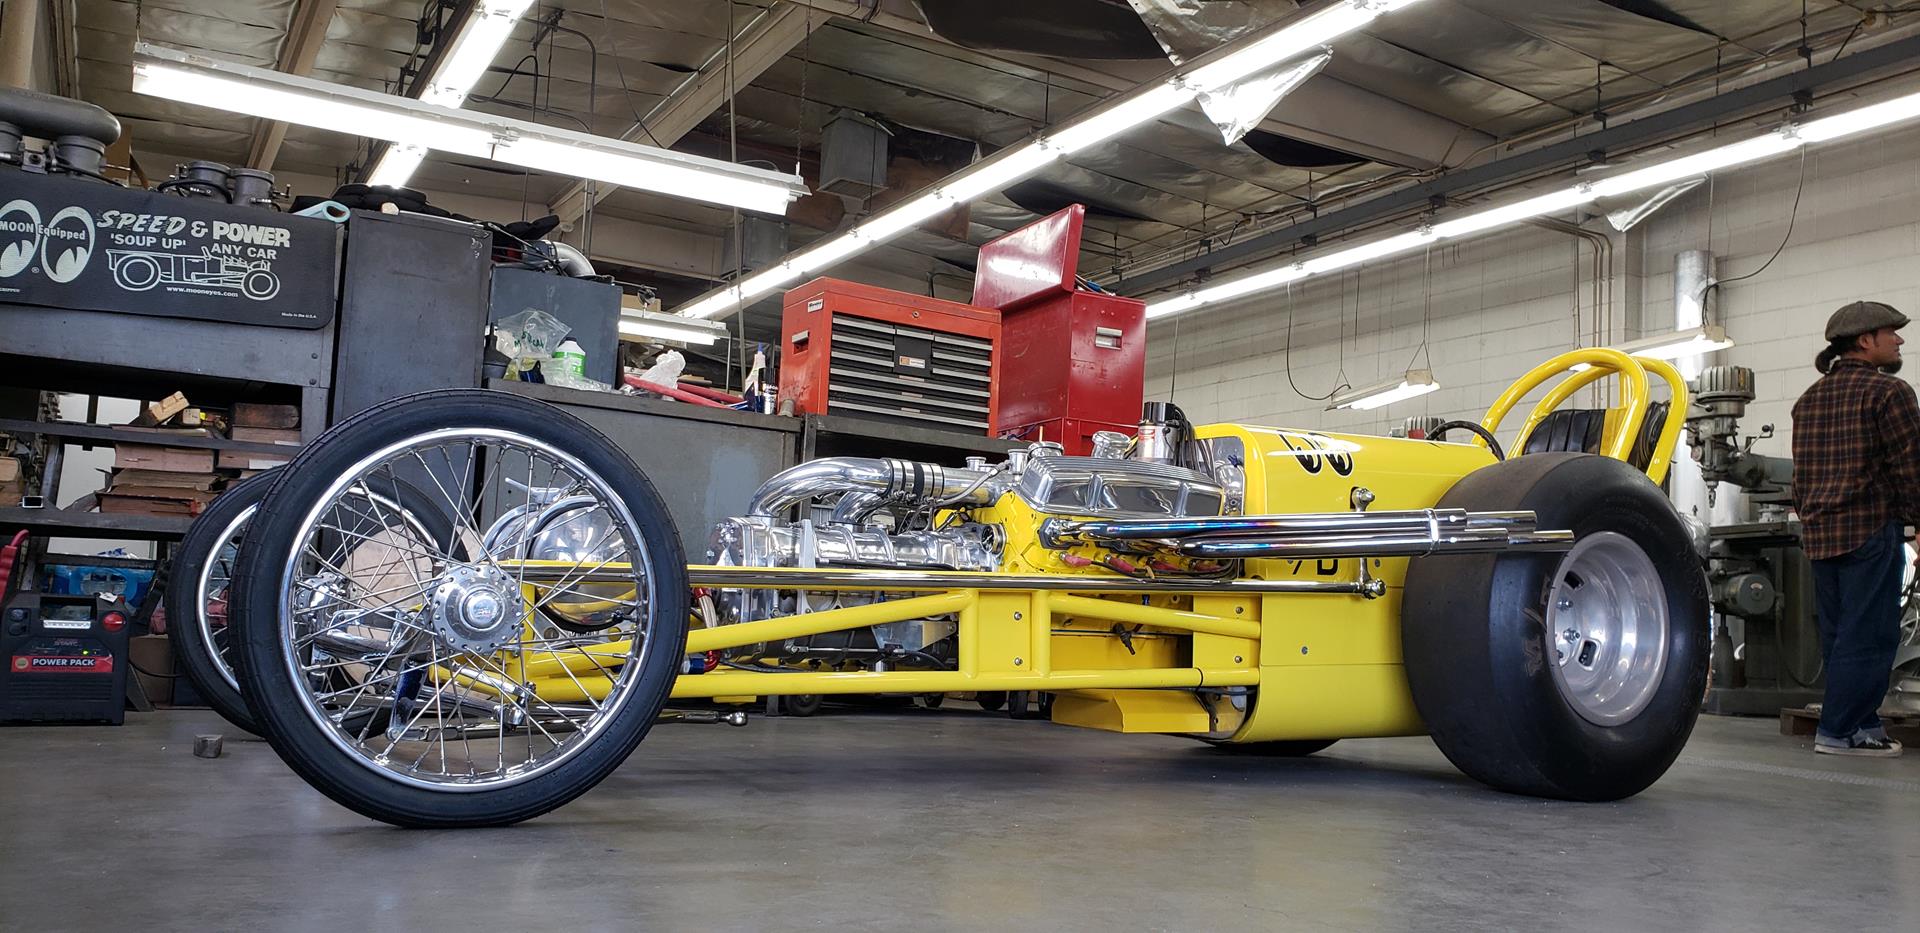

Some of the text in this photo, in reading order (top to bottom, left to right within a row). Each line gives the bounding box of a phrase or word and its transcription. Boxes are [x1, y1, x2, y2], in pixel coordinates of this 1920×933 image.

[38, 224, 86, 240] Equipped
[96, 210, 291, 248] SPEED & POWER
[110, 233, 187, 250] 'SOUP UP'
[211, 242, 277, 260] ANY CAR
[166, 286, 239, 298] www.mooneyes.com
[32, 658, 68, 666] POWER
